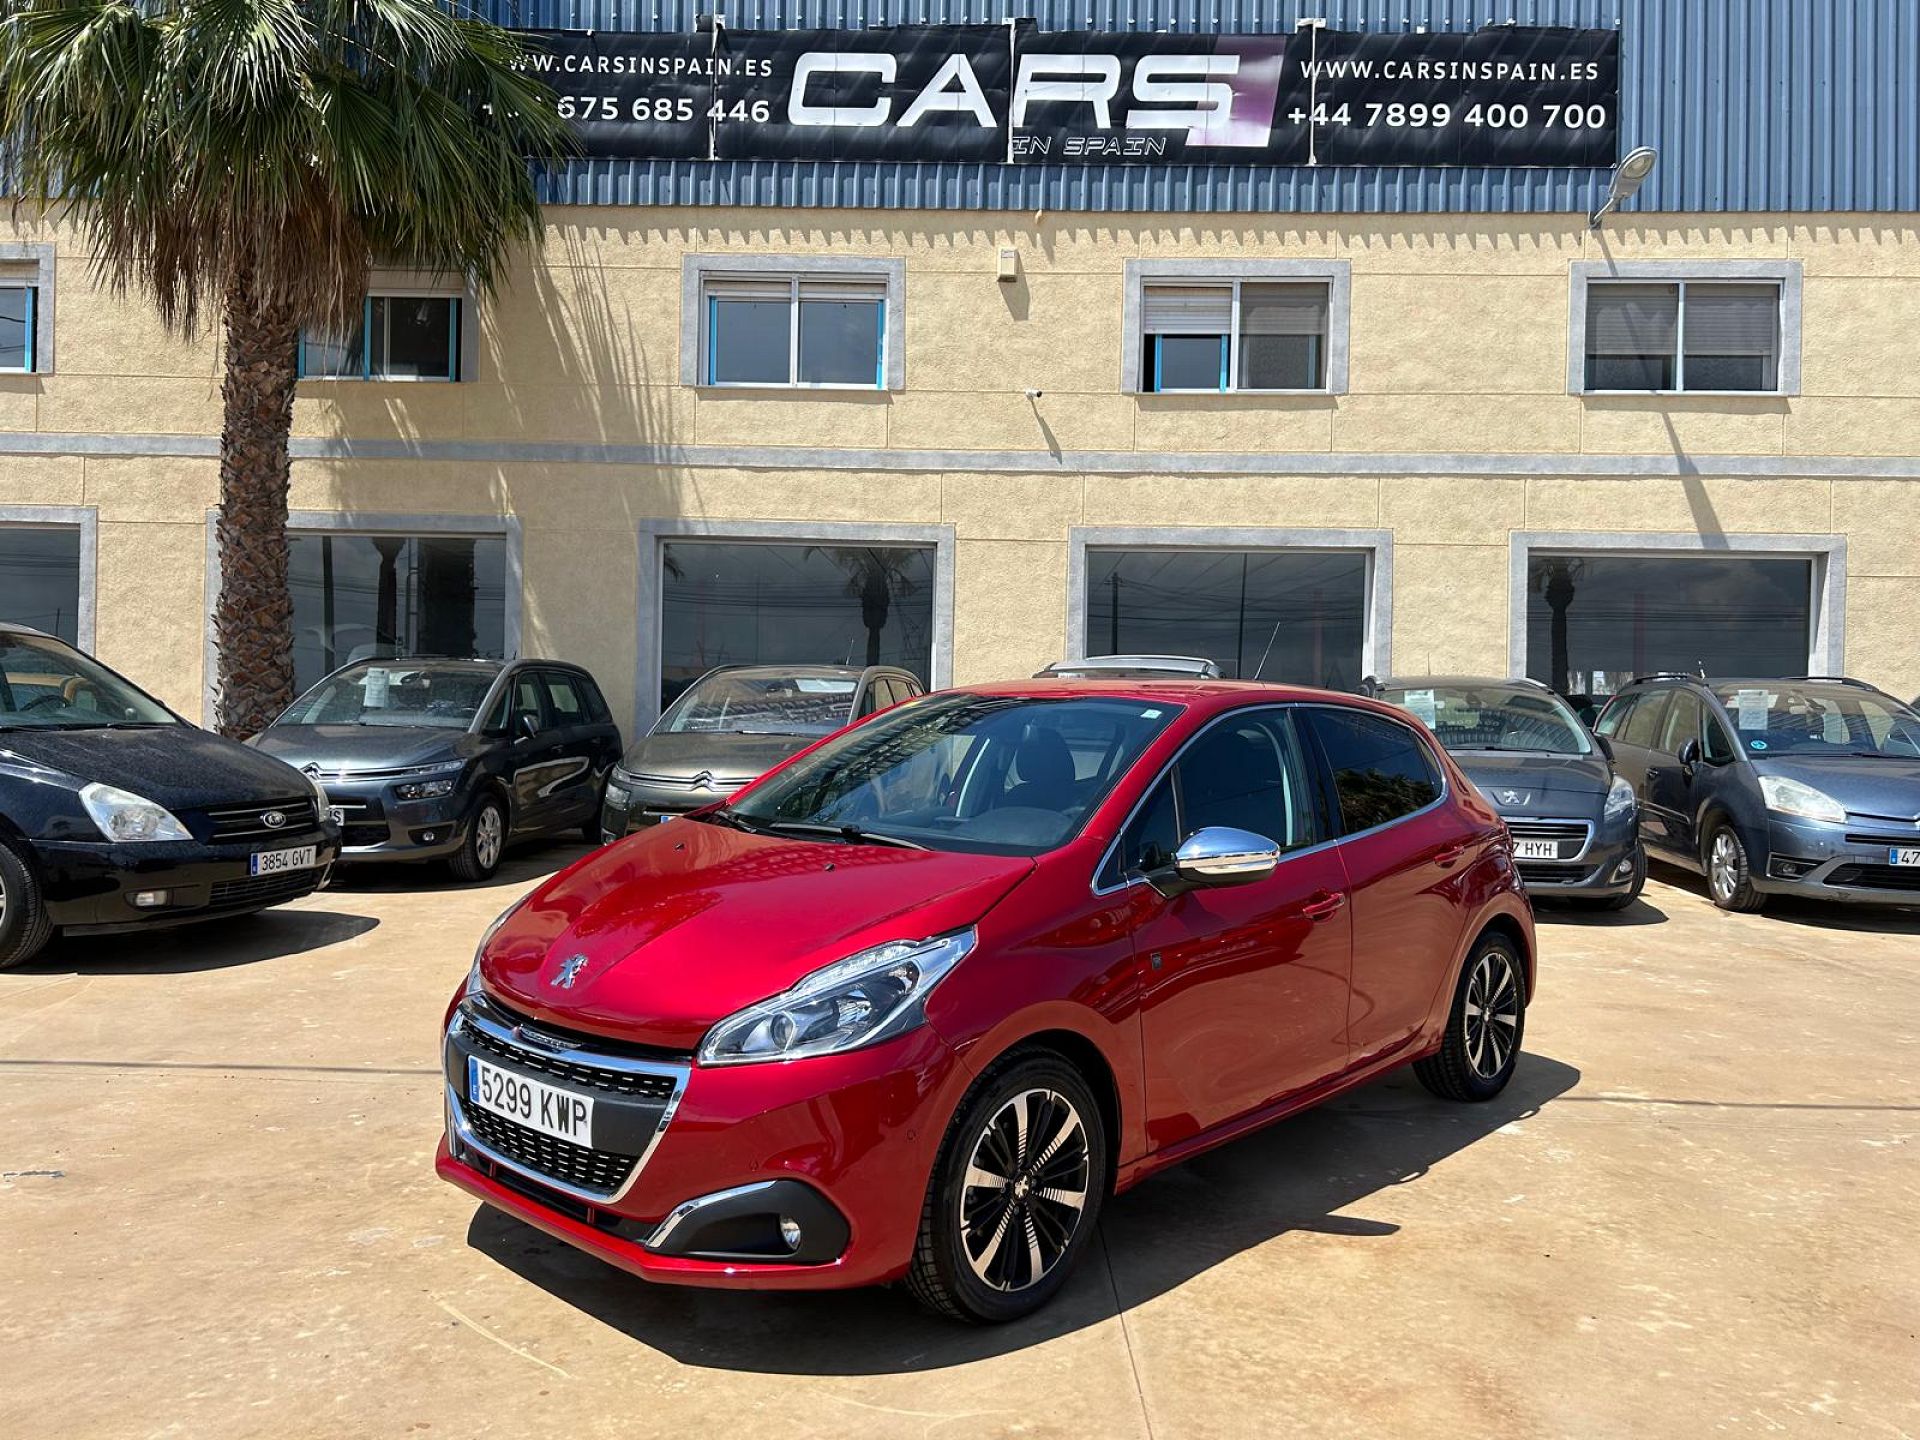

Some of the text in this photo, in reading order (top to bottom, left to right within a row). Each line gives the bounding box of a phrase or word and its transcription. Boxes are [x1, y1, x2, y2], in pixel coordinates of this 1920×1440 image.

[1300, 60, 1599, 81] WWW.CARSINSPAIN.ES
[787, 52, 1241, 129] CARS
[557, 95, 620, 120] 675
[631, 97, 694, 121] 685
[706, 98, 770, 123] 446
[1288, 102, 1606, 129] +44 7899 400 700
[1012, 136, 1167, 156] IN SPAIN
[262, 848, 313, 871] 3854 GVT
[1524, 842, 1553, 857] HYH
[481, 1065, 587, 1136] 5299 KWP
